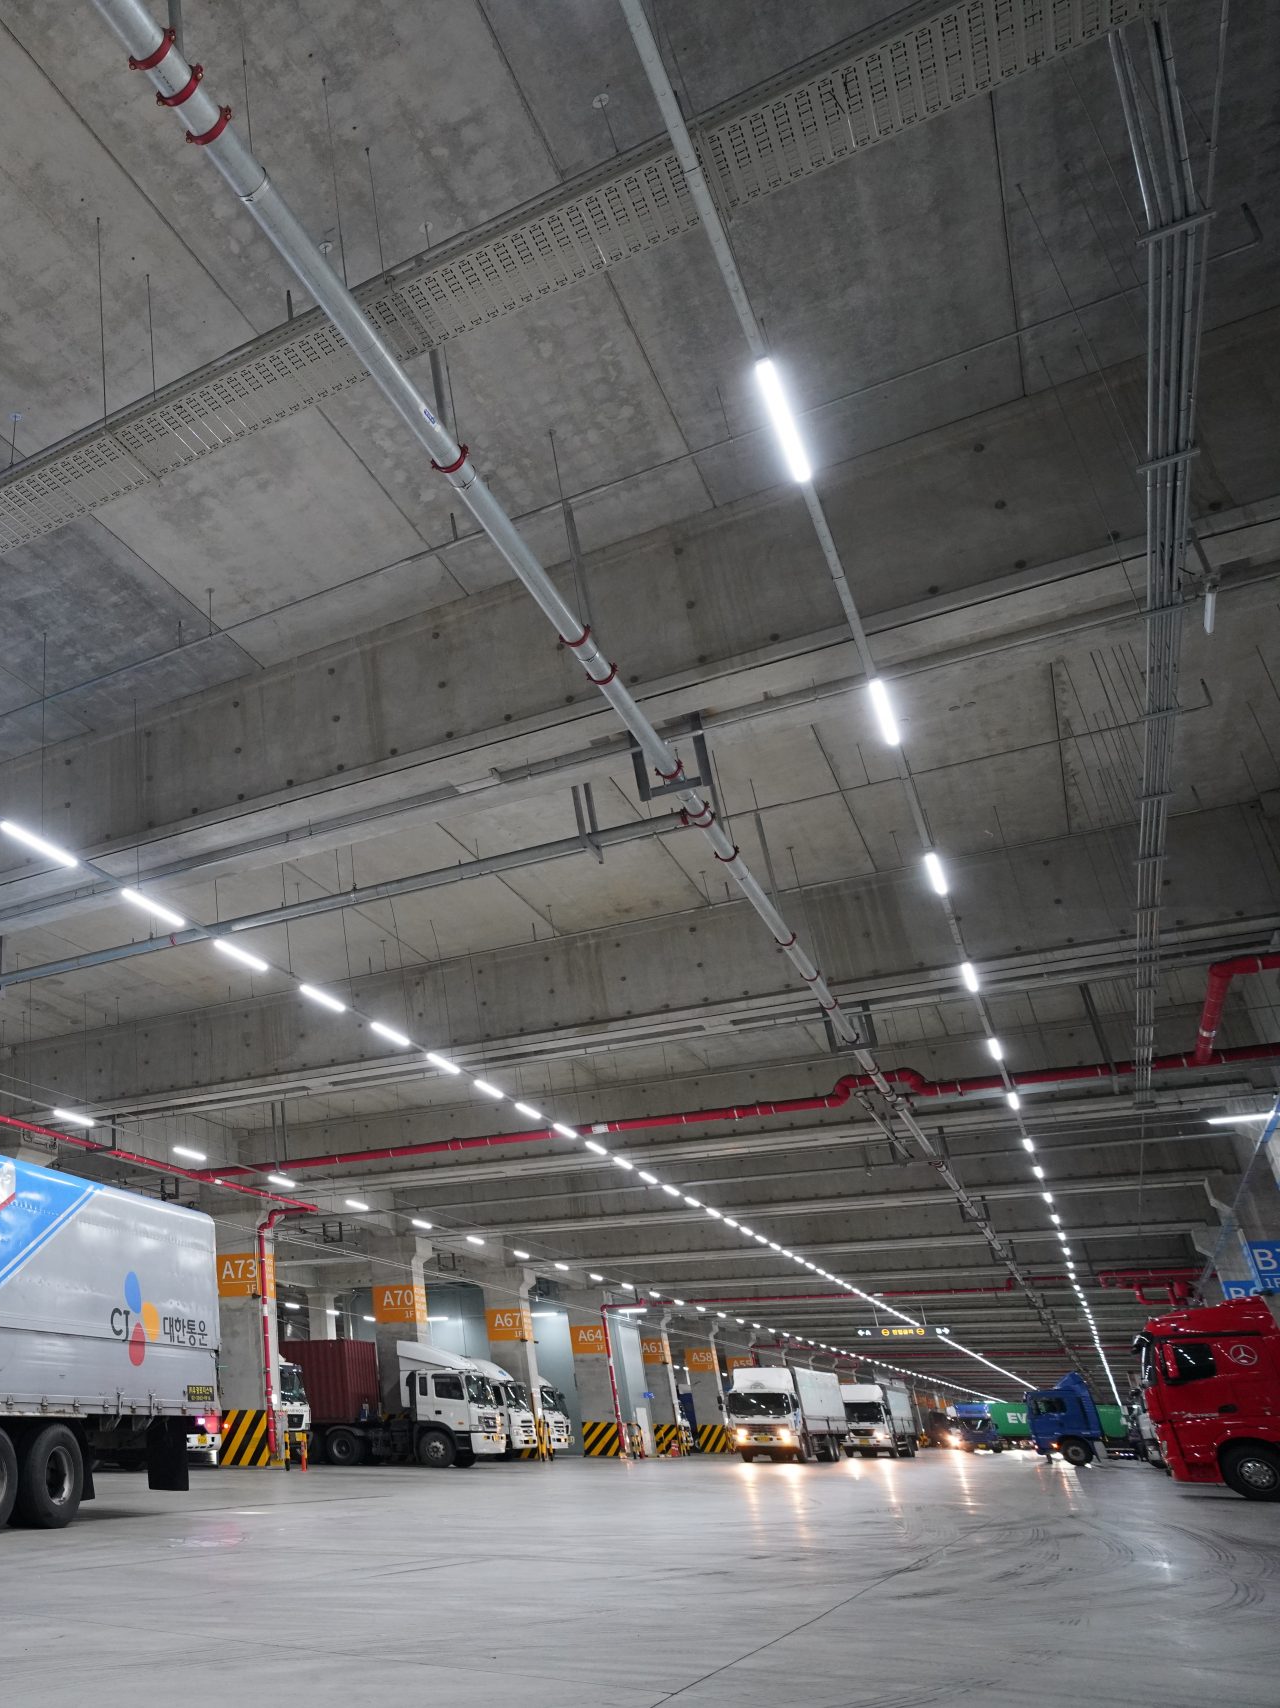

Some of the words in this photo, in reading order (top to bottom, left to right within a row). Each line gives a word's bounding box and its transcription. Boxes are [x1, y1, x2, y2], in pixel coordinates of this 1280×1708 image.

[1253, 1248, 1280, 1270] B
[222, 1259, 257, 1279] A73
[246, 1284, 257, 1294] 1F
[383, 1289, 414, 1306] A70
[404, 1310, 415, 1319] 1F
[494, 1313, 521, 1328] A67
[110, 1307, 130, 1342] CJ
[163, 1317, 208, 1346] 대한통운
[578, 1329, 603, 1342] A64
[642, 1342, 665, 1353] A61
[692, 1352, 713, 1363] A58
